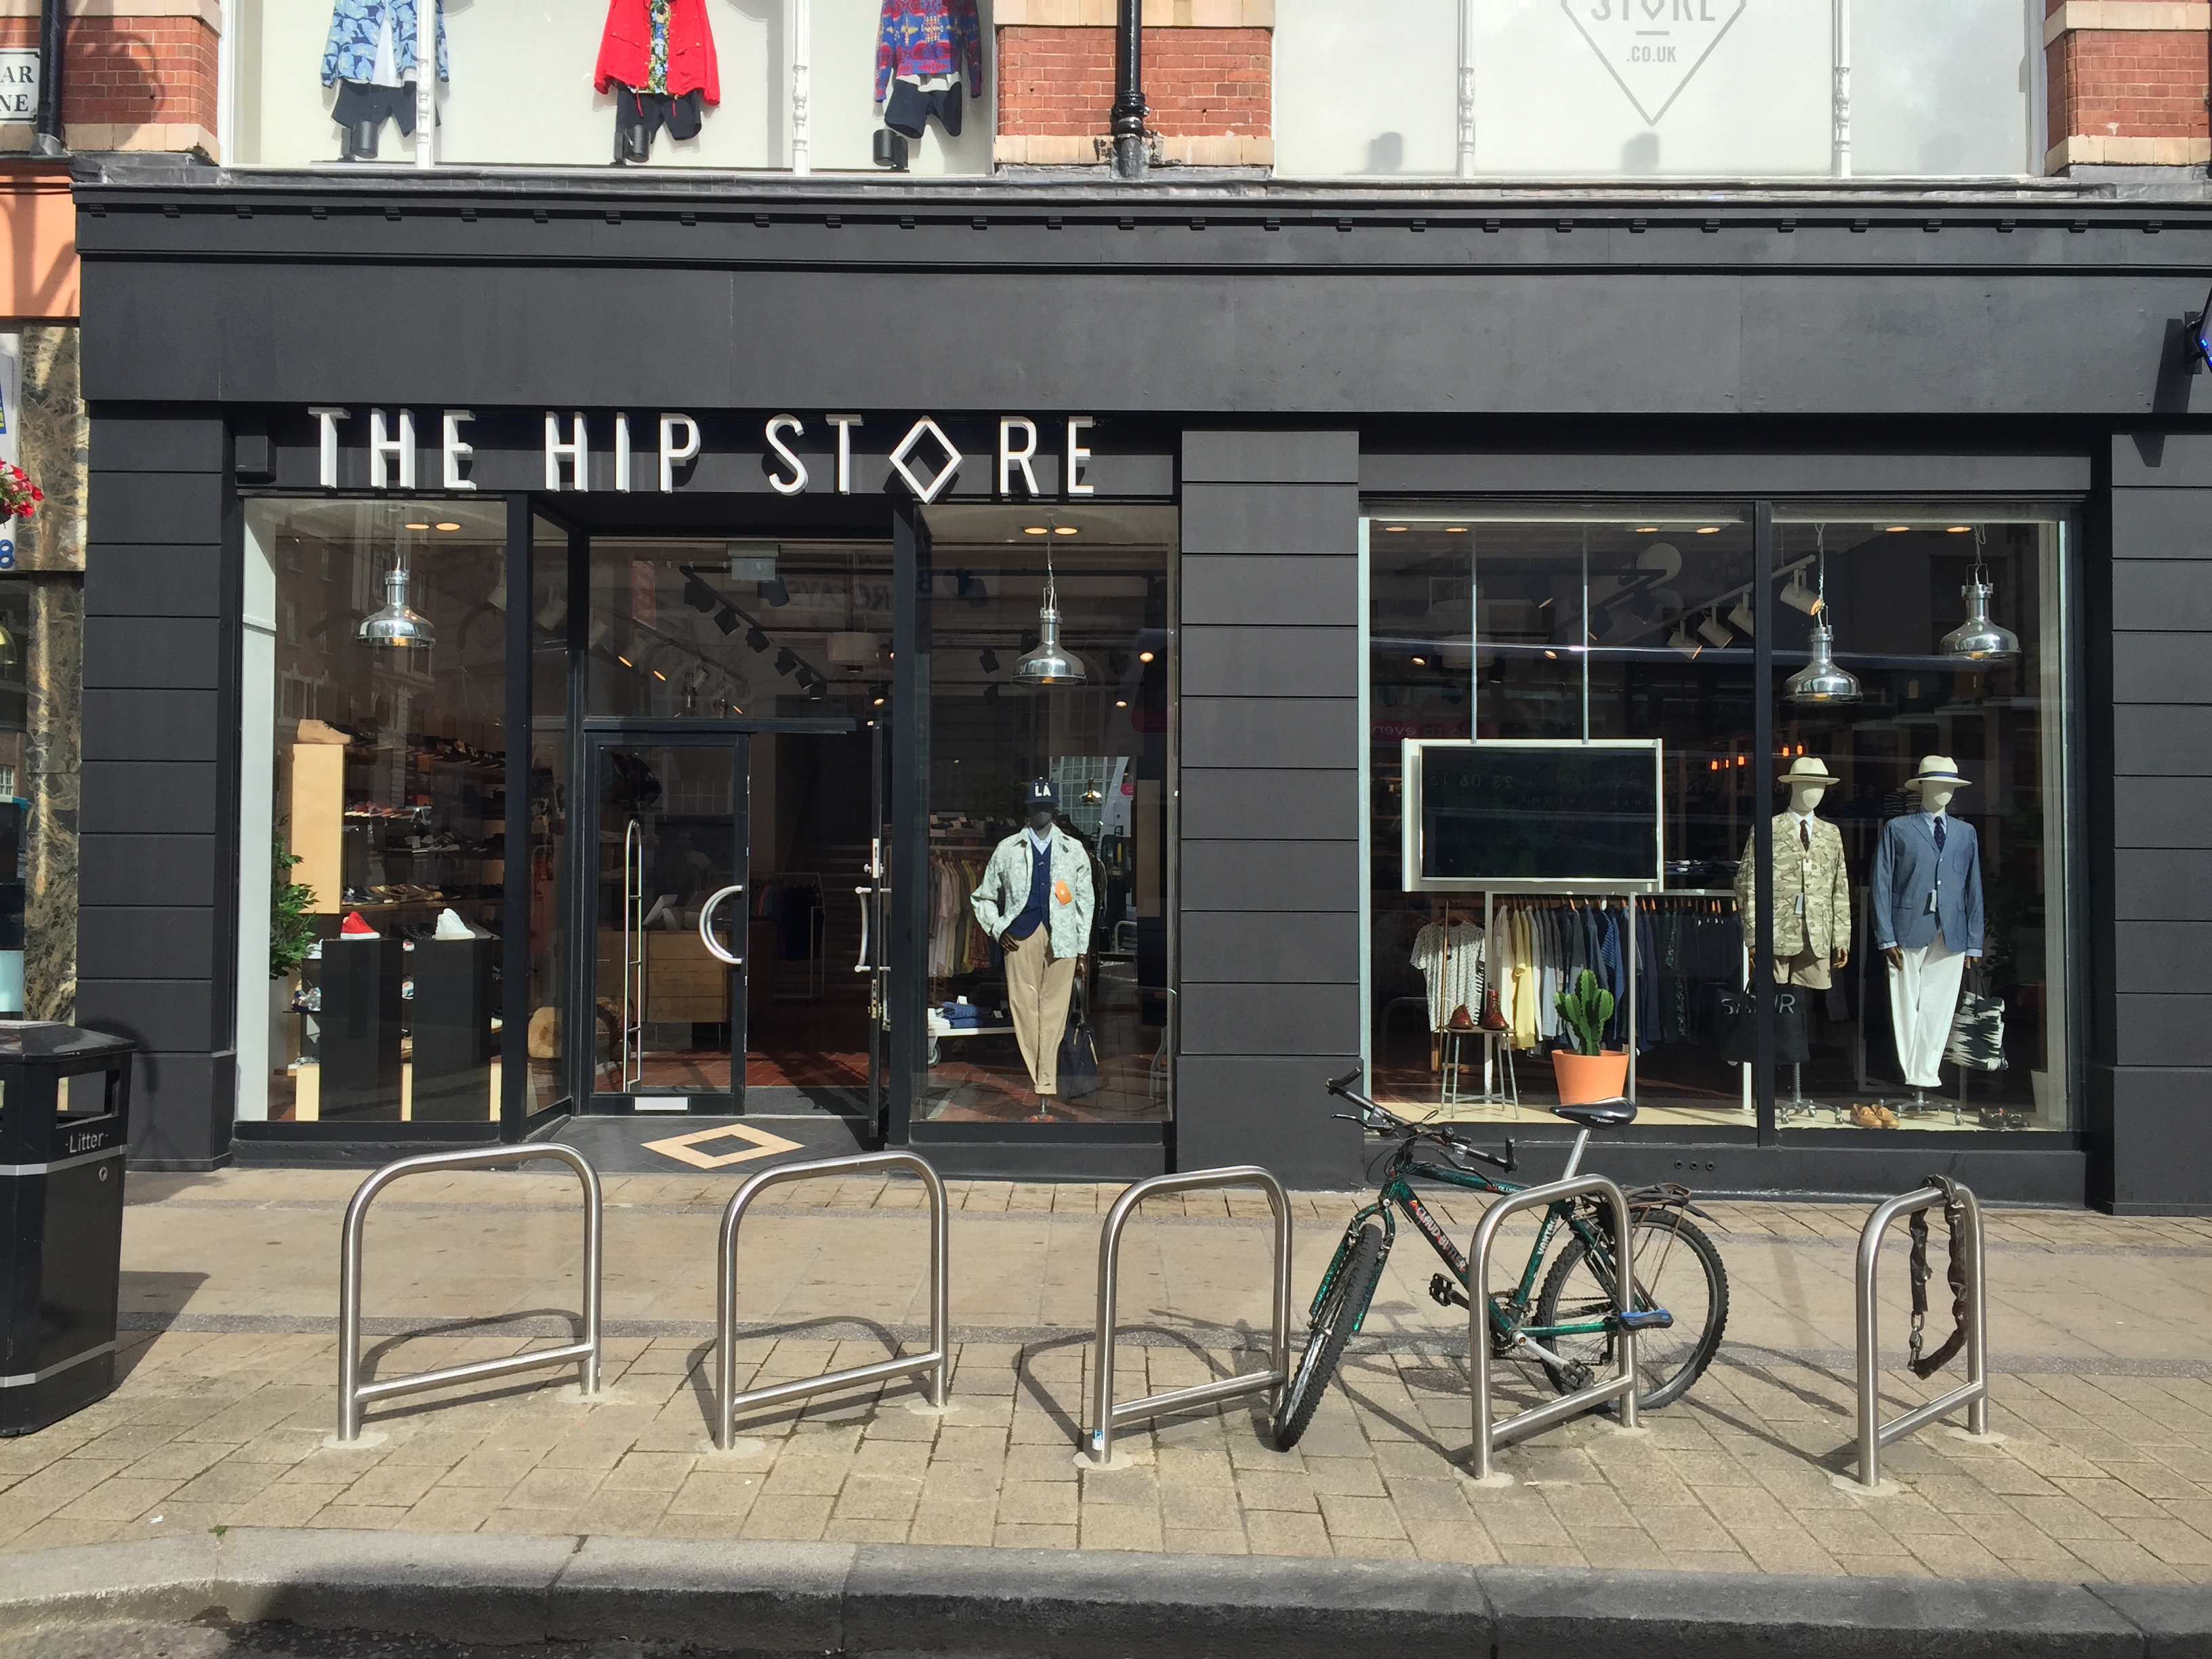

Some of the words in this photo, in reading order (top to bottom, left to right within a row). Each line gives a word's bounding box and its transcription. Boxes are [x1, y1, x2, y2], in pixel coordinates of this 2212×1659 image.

[1626, 46, 1676, 62] .CO.UK
[308, 407, 476, 491] THE
[545, 410, 701, 493] HIP
[765, 413, 1094, 504] STORE
[1035, 785, 1051, 797] LA
[69, 1132, 104, 1153] Litter
